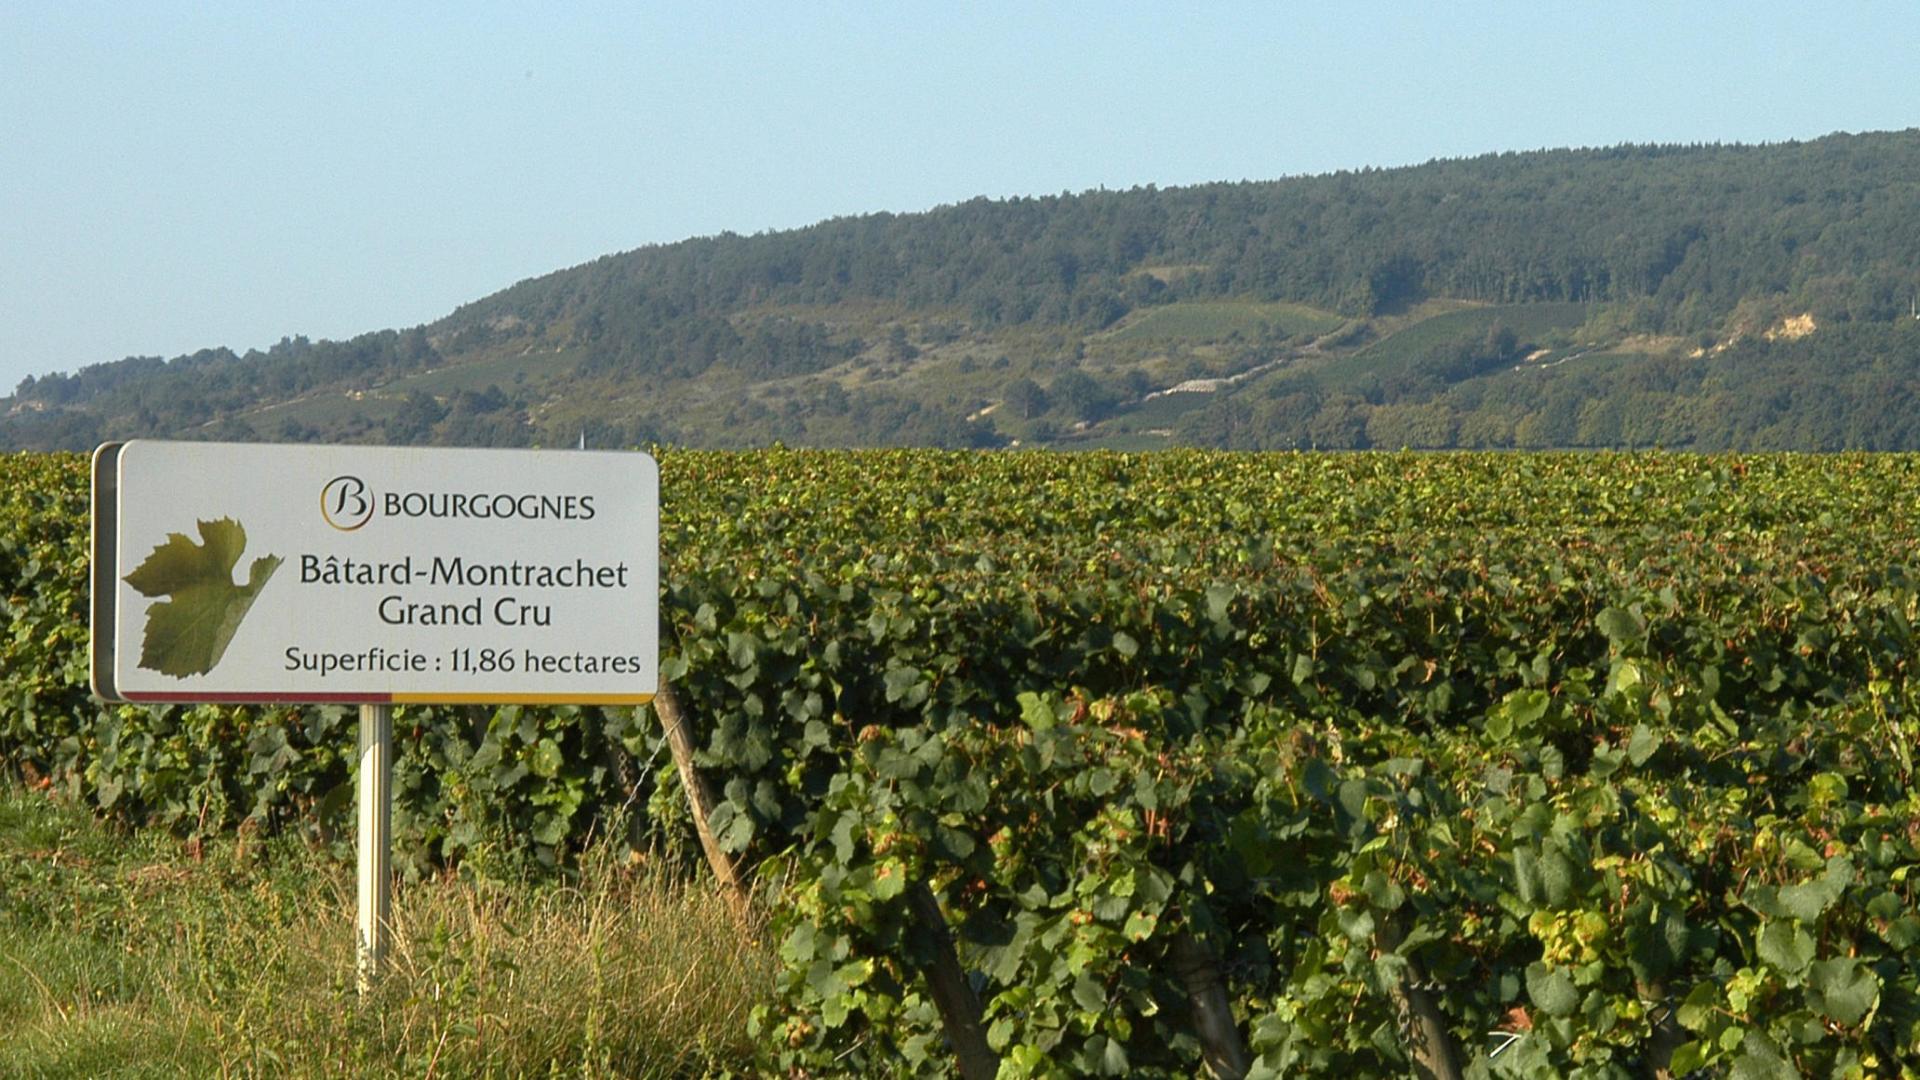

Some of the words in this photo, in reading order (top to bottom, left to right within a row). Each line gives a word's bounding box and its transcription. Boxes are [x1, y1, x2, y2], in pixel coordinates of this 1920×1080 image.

[384, 492, 596, 520] BOURGOGNES
[300, 554, 629, 588] Bâtard-Montrachet
[378, 595, 482, 627] Grand
[494, 597, 551, 627] Cru
[286, 647, 427, 677] Superficie
[451, 647, 516, 676] 11,86
[525, 649, 641, 674] hectares
